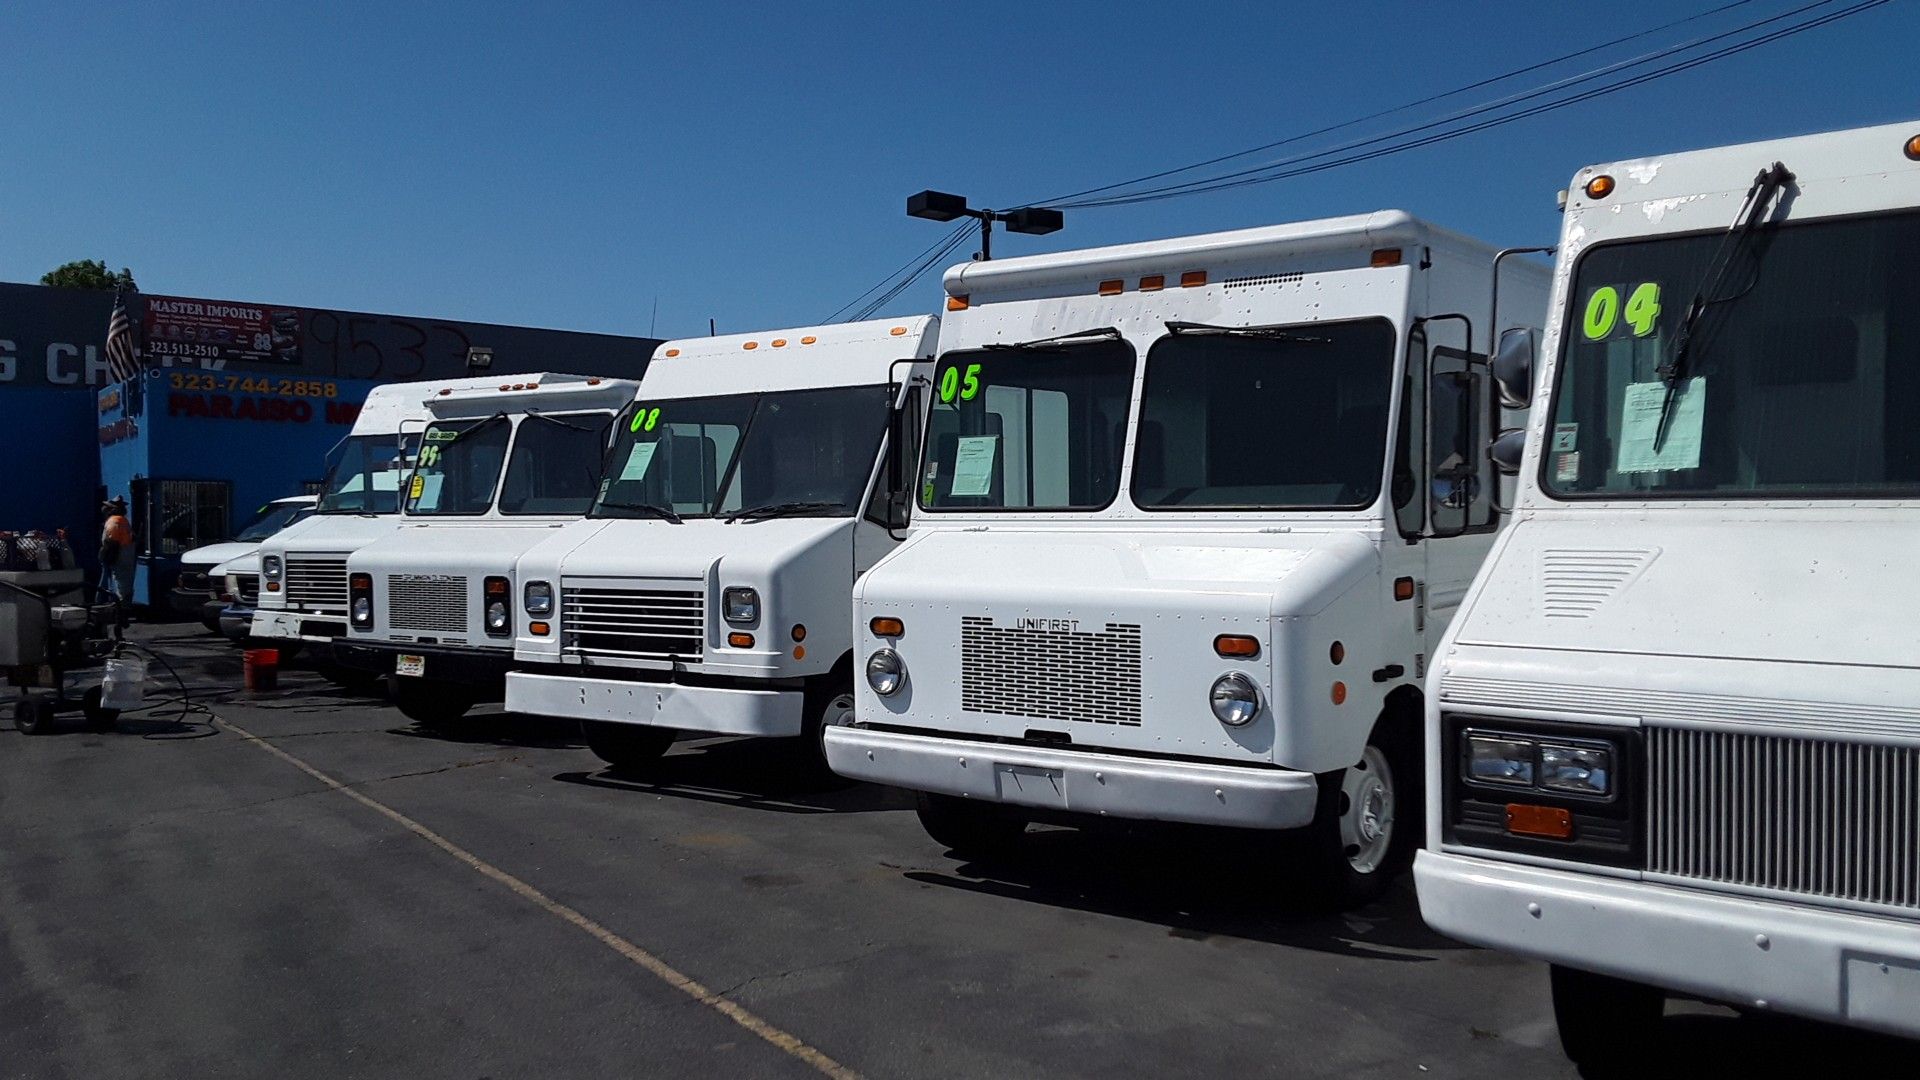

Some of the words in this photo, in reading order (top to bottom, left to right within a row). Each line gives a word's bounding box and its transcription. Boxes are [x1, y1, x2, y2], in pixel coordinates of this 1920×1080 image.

[149, 299, 204, 316] MASTER
[207, 304, 263, 321] IMPORTS
[1583, 282, 1661, 341] 04
[150, 341, 219, 358] 323.513-2510
[168, 372, 338, 398] 323-744-2858
[941, 363, 981, 403] 05
[167, 393, 313, 423] PARAISO
[630, 408, 660, 433] 08
[1016, 617, 1079, 632] UNIFIRST
